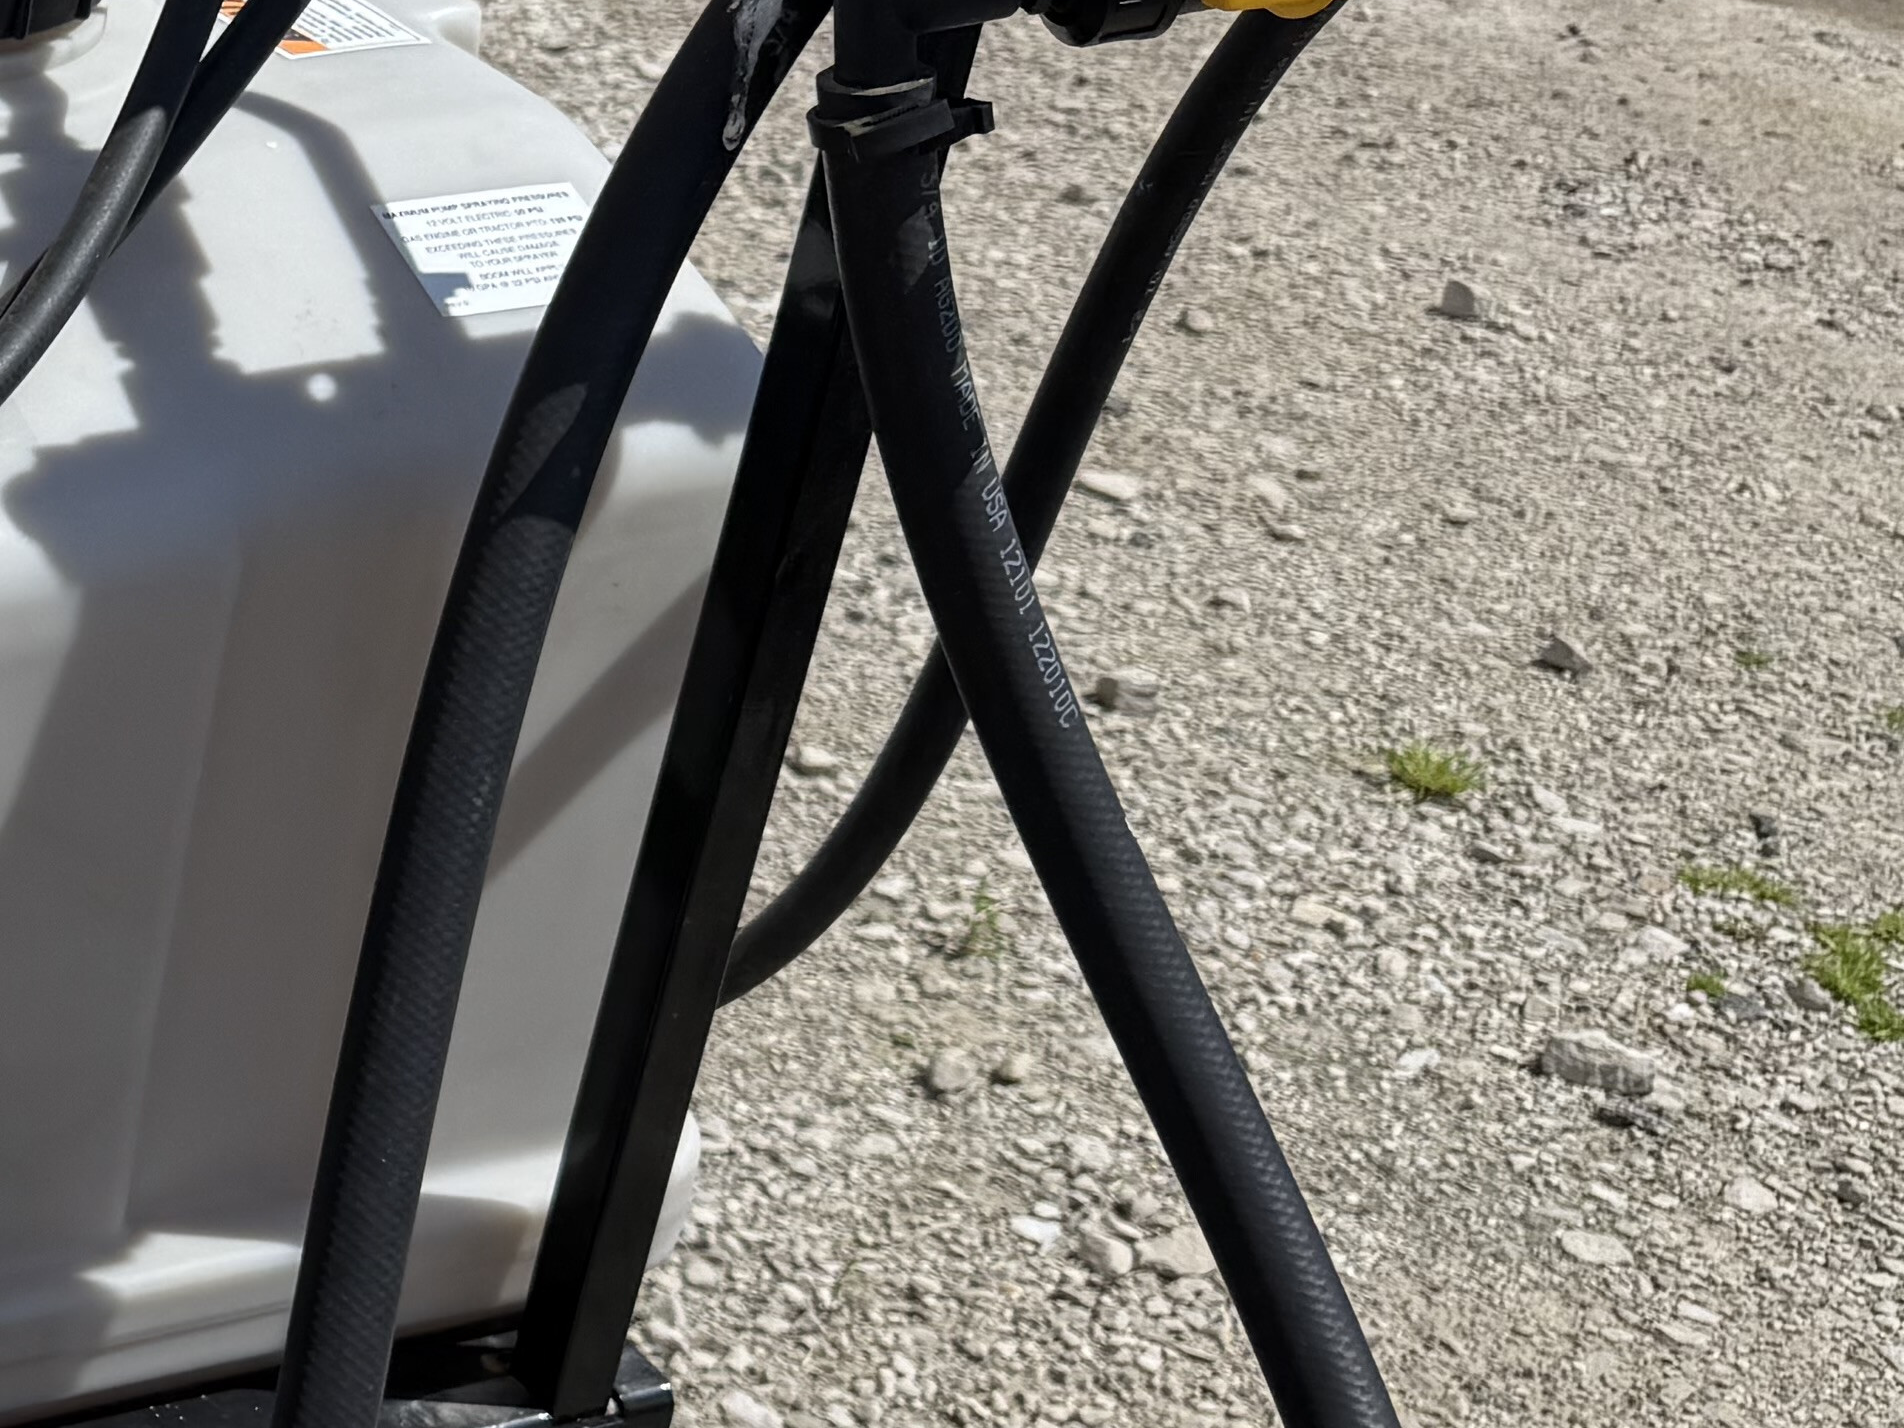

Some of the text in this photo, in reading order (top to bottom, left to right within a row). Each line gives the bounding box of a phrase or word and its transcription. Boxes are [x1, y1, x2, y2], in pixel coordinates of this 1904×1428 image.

[951, 362, 983, 432] MADE
[969, 435, 993, 476] IN
[980, 477, 1007, 533] USA
[1000, 535, 1037, 617] 12101
[1028, 620, 1080, 729] 122010C
